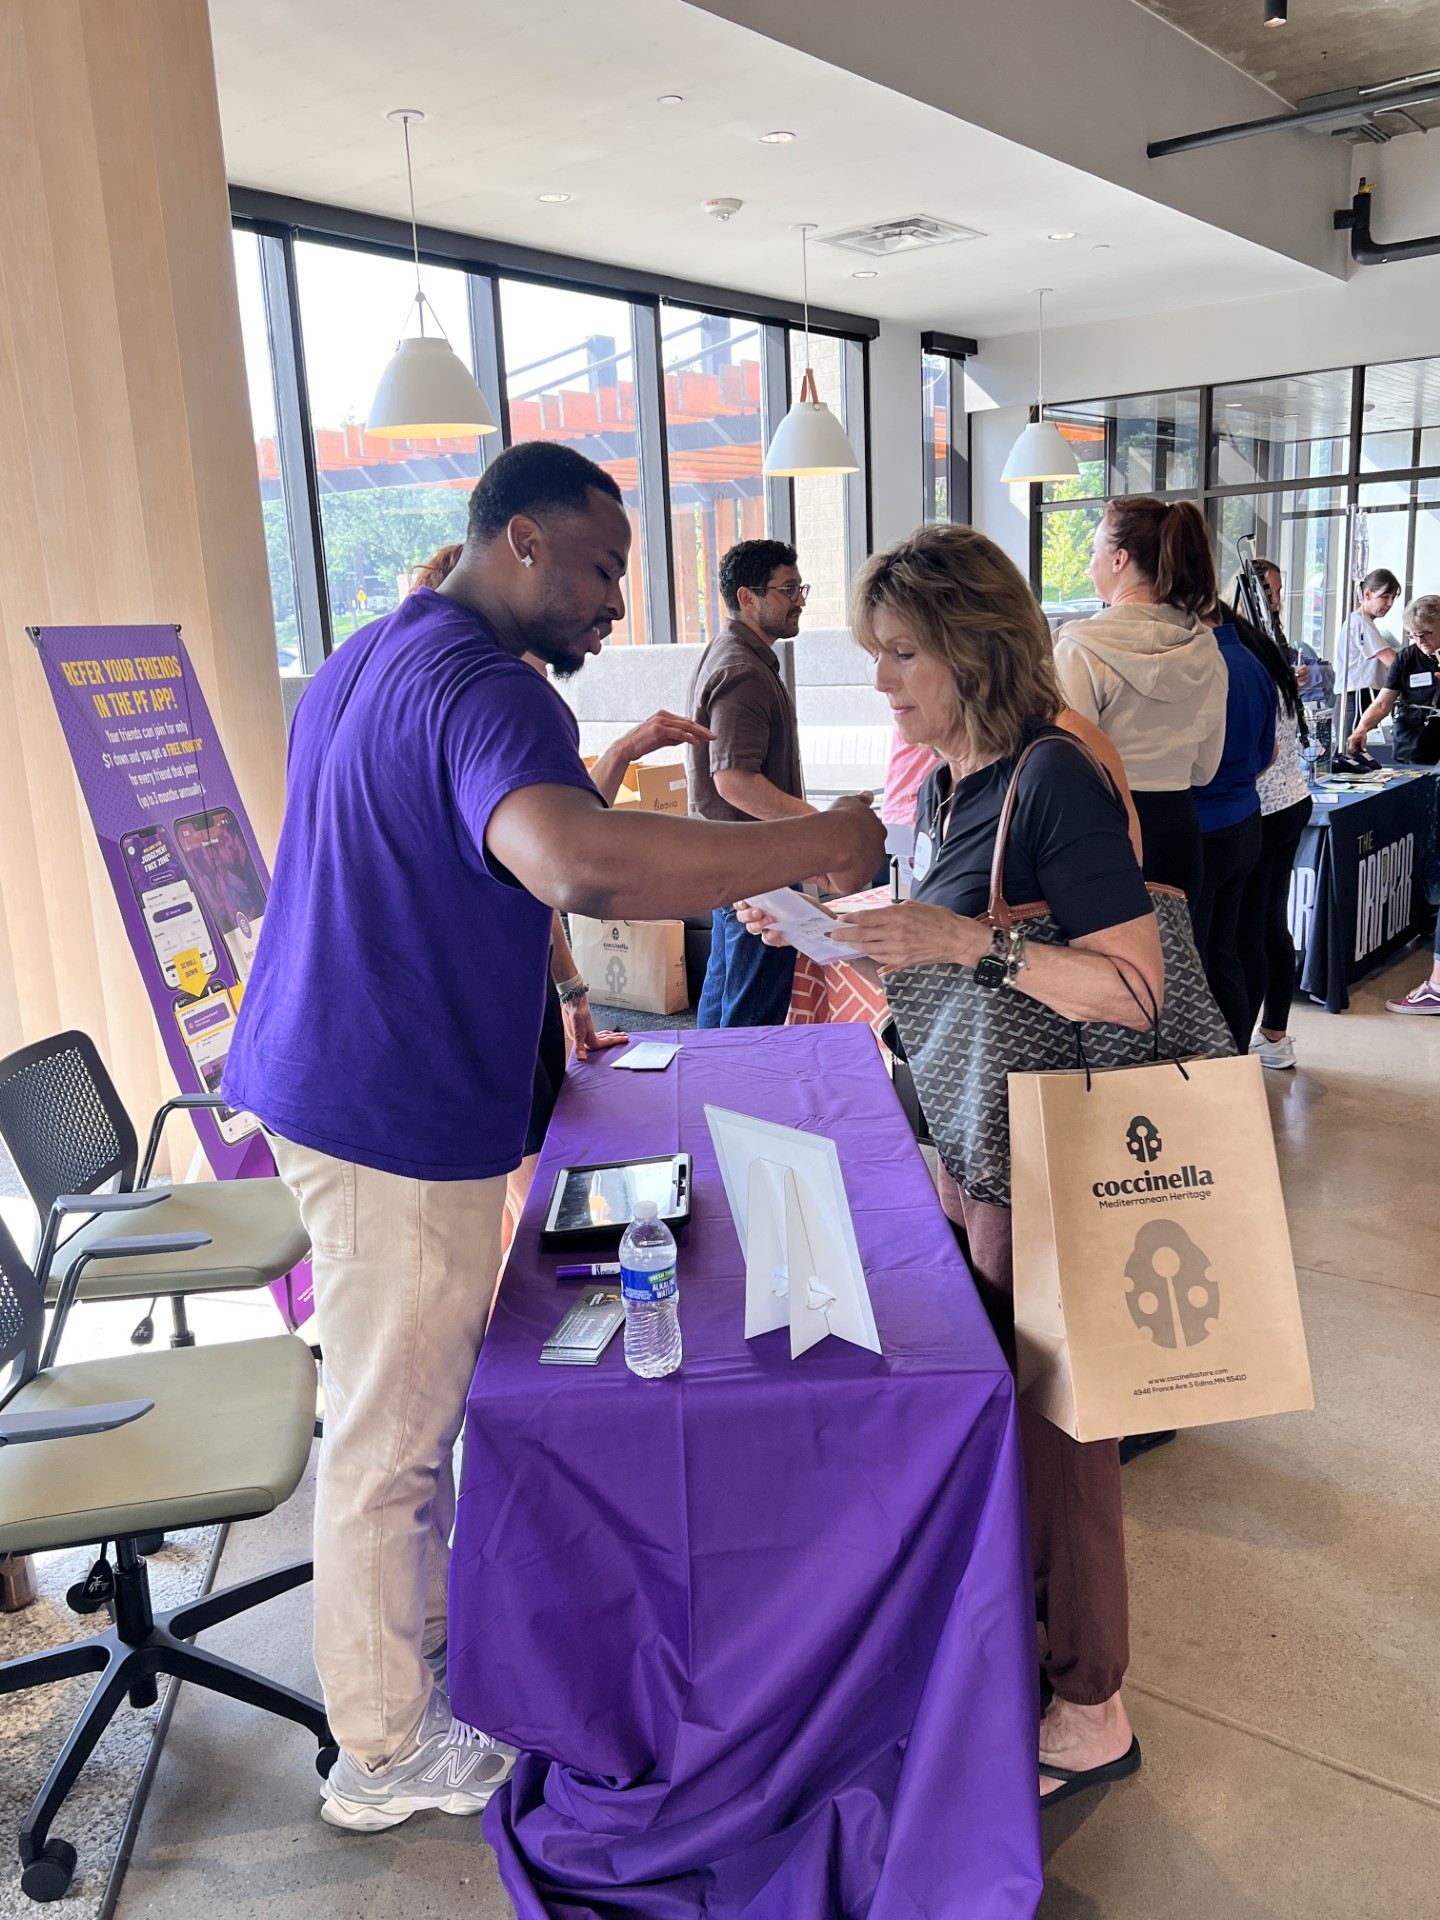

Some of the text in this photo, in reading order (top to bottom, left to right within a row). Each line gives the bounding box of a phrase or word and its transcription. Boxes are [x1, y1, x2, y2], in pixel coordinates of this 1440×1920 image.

[61, 656, 182, 686] REFER YOUR FRIENDS
[92, 687, 178, 718] IN THE PF APP!
[104, 720, 189, 743] Your friends can join for only
[102, 752, 114, 769] $1
[113, 752, 130, 766] down
[128, 749, 141, 764] and
[139, 751, 152, 765] you
[151, 746, 163, 763] get
[129, 762, 199, 786] for every friend that joins
[157, 788, 180, 804] months
[1357, 830, 1374, 855] THE
[180, 958, 197, 970] SCROLL
[185, 968, 199, 979] DOWN
[1092, 1165, 1215, 1198] coccinella
[1099, 1190, 1212, 1209] Mediterranean Heritage
[1148, 1368, 1229, 1385] www.coccinellastore.com
[1152, 1384, 1174, 1393] France
[1226, 1374, 1247, 1383] 55410
